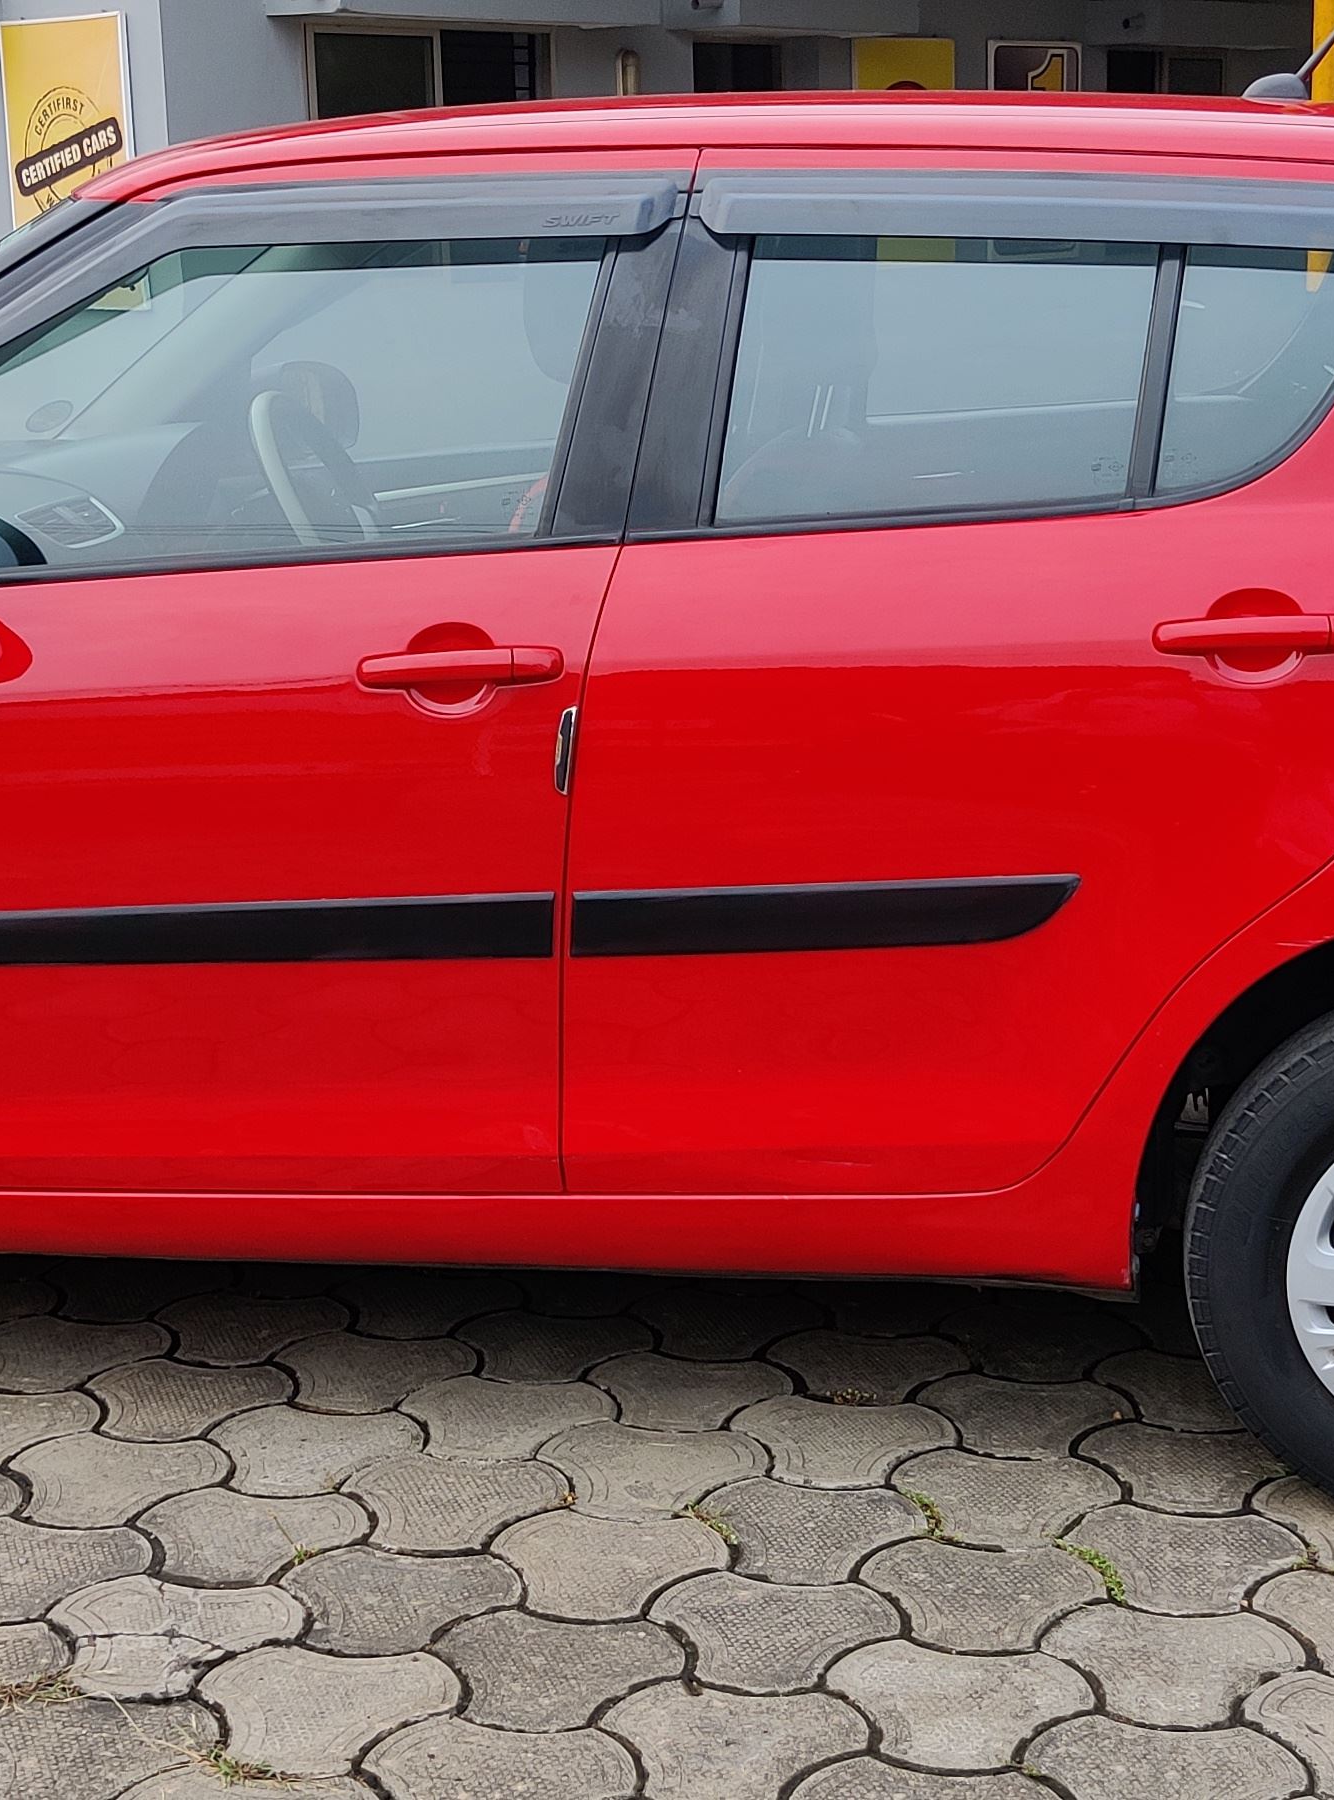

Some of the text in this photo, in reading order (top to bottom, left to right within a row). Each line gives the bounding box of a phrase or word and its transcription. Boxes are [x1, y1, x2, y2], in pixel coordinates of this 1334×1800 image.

[34, 96, 84, 136] CERTIFIRST
[21, 125, 117, 188] CERTIFIED CARS
[542, 214, 619, 228] SWIFT
